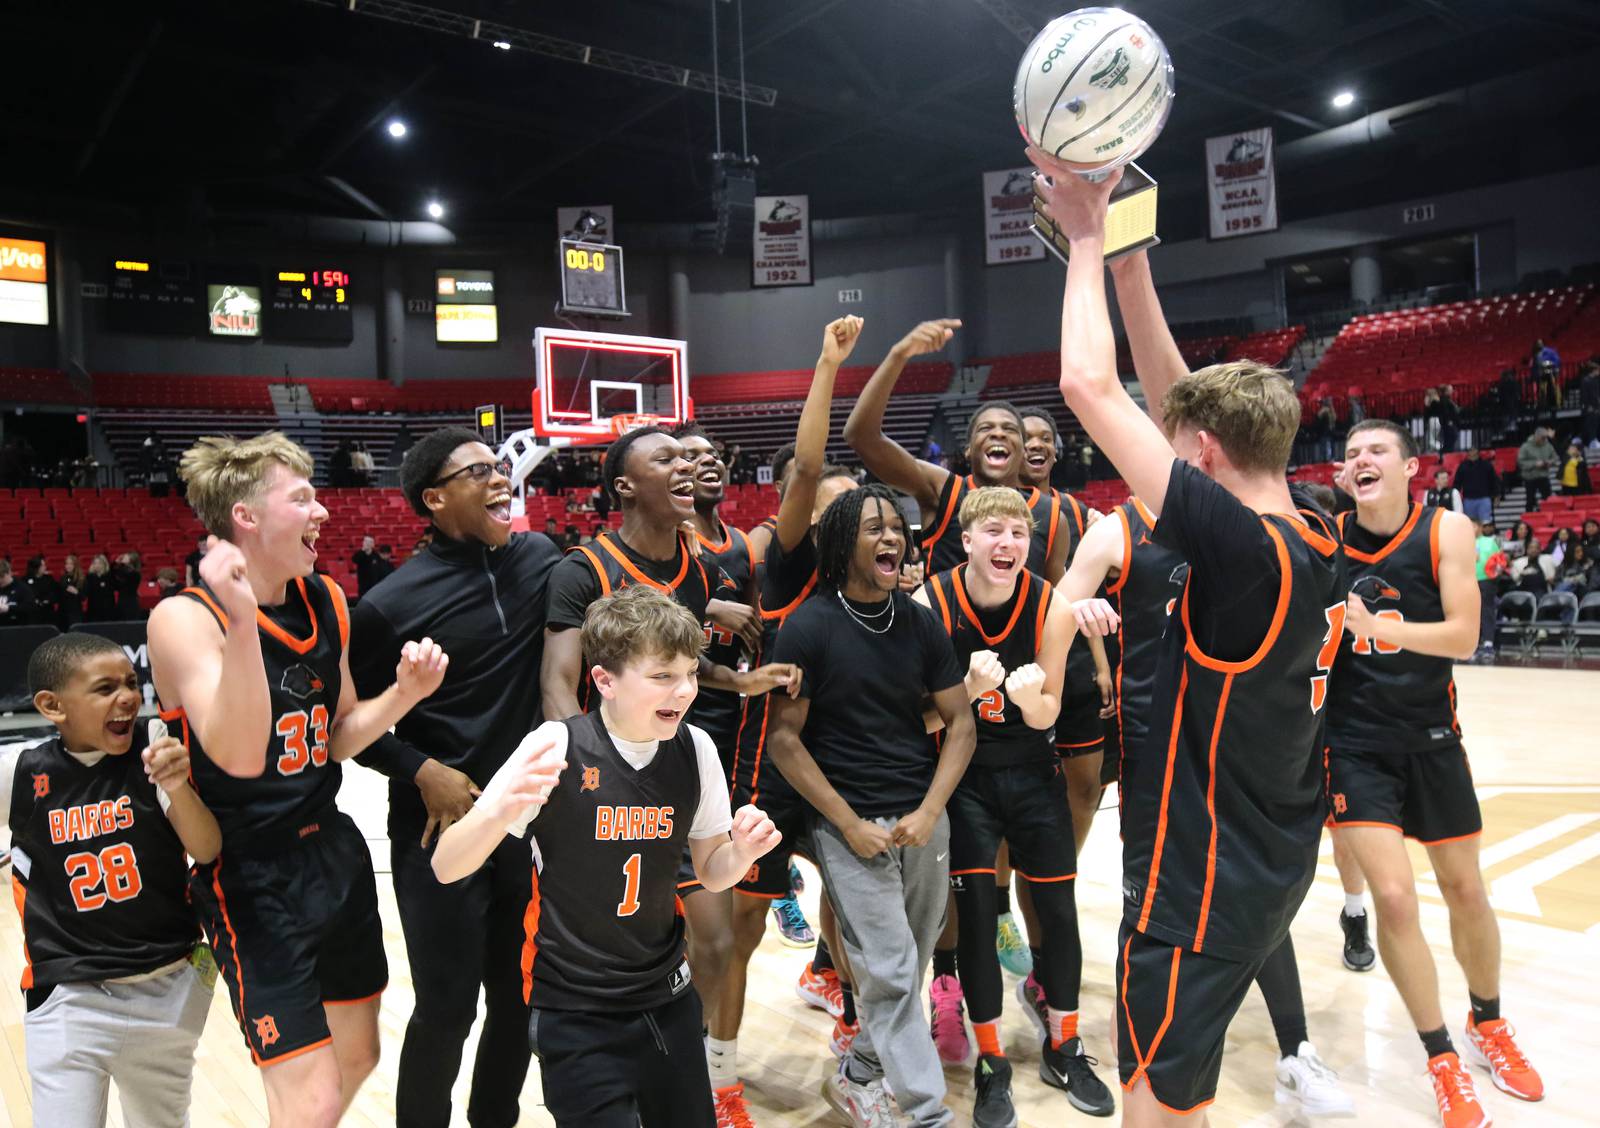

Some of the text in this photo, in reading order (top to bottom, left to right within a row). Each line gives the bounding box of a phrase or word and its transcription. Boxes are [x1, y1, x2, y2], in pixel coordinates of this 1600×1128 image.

[1093, 136, 1124, 154] BANK
[1224, 187, 1258, 201] NCAA
[1000, 219, 1030, 232] NCAA
[1225, 215, 1263, 232] 1995
[0, 246, 44, 270] Vee
[999, 244, 1032, 260] 1992
[756, 260, 807, 269] CHAMPIONS
[766, 269, 797, 282] 1992
[456, 281, 494, 292] TOYOTA
[211, 314, 255, 329] NIU
[978, 689, 1005, 723] 2
[276, 704, 329, 777] 33
[48, 795, 135, 844] BARBS
[595, 805, 675, 841] BARBS
[64, 842, 142, 912] 28
[616, 853, 642, 917] 1
